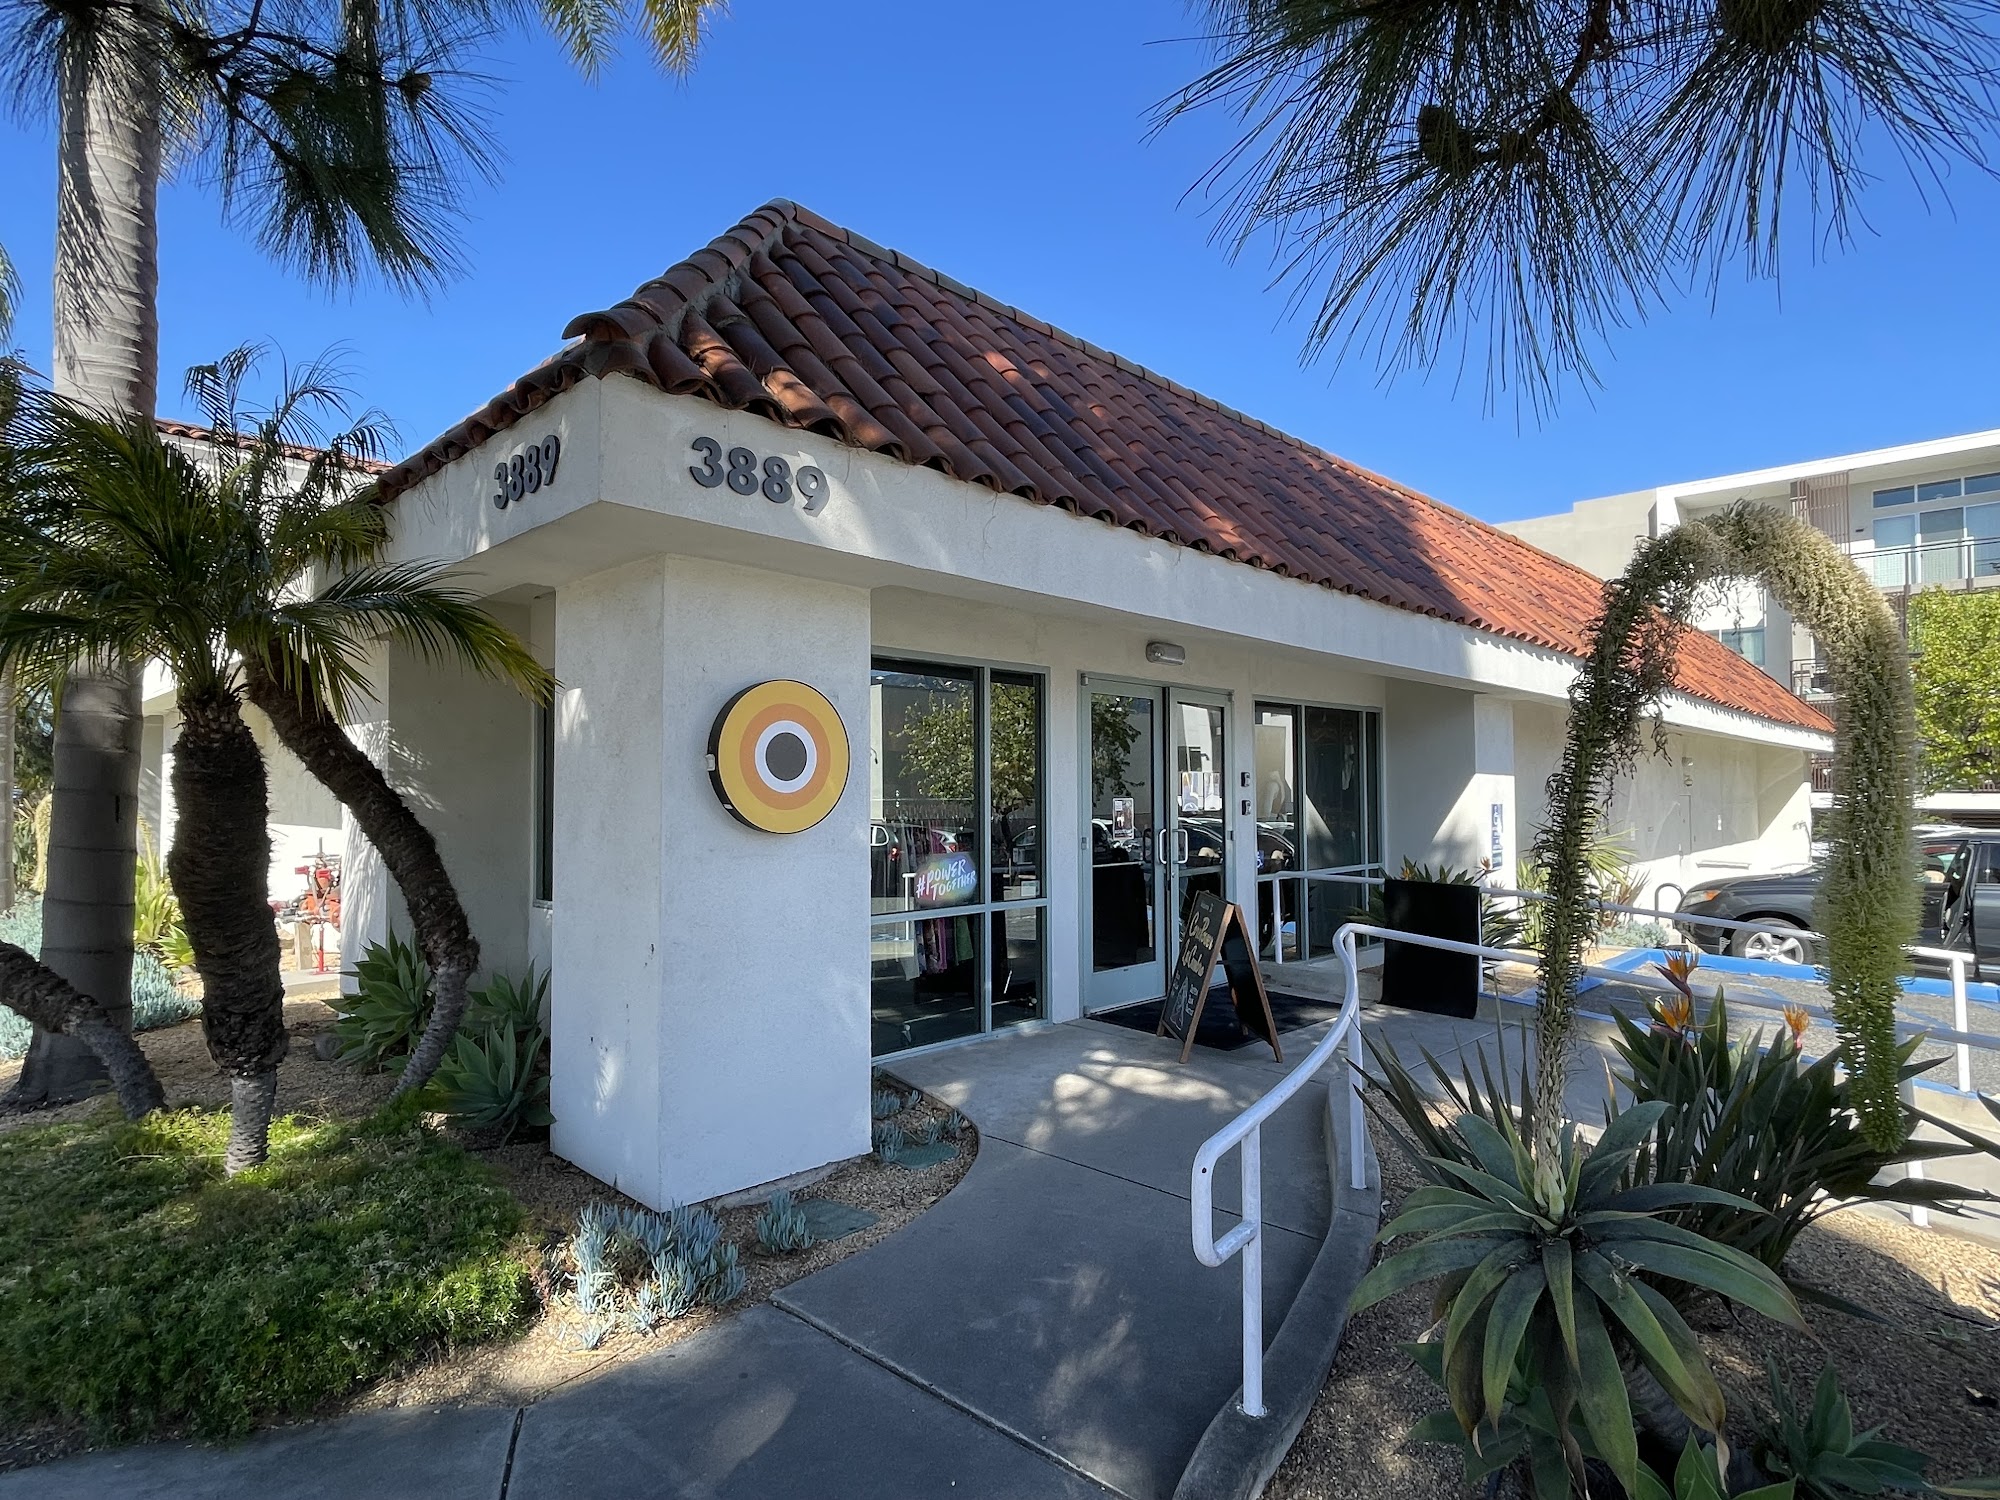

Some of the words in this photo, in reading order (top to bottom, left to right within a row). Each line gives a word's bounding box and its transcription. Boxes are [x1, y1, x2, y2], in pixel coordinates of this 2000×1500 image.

[493, 434, 561, 509] 3889
[690, 436, 831, 517] 3889
[916, 859, 966, 898] #POWER
[931, 871, 976, 900] TOGETHER
